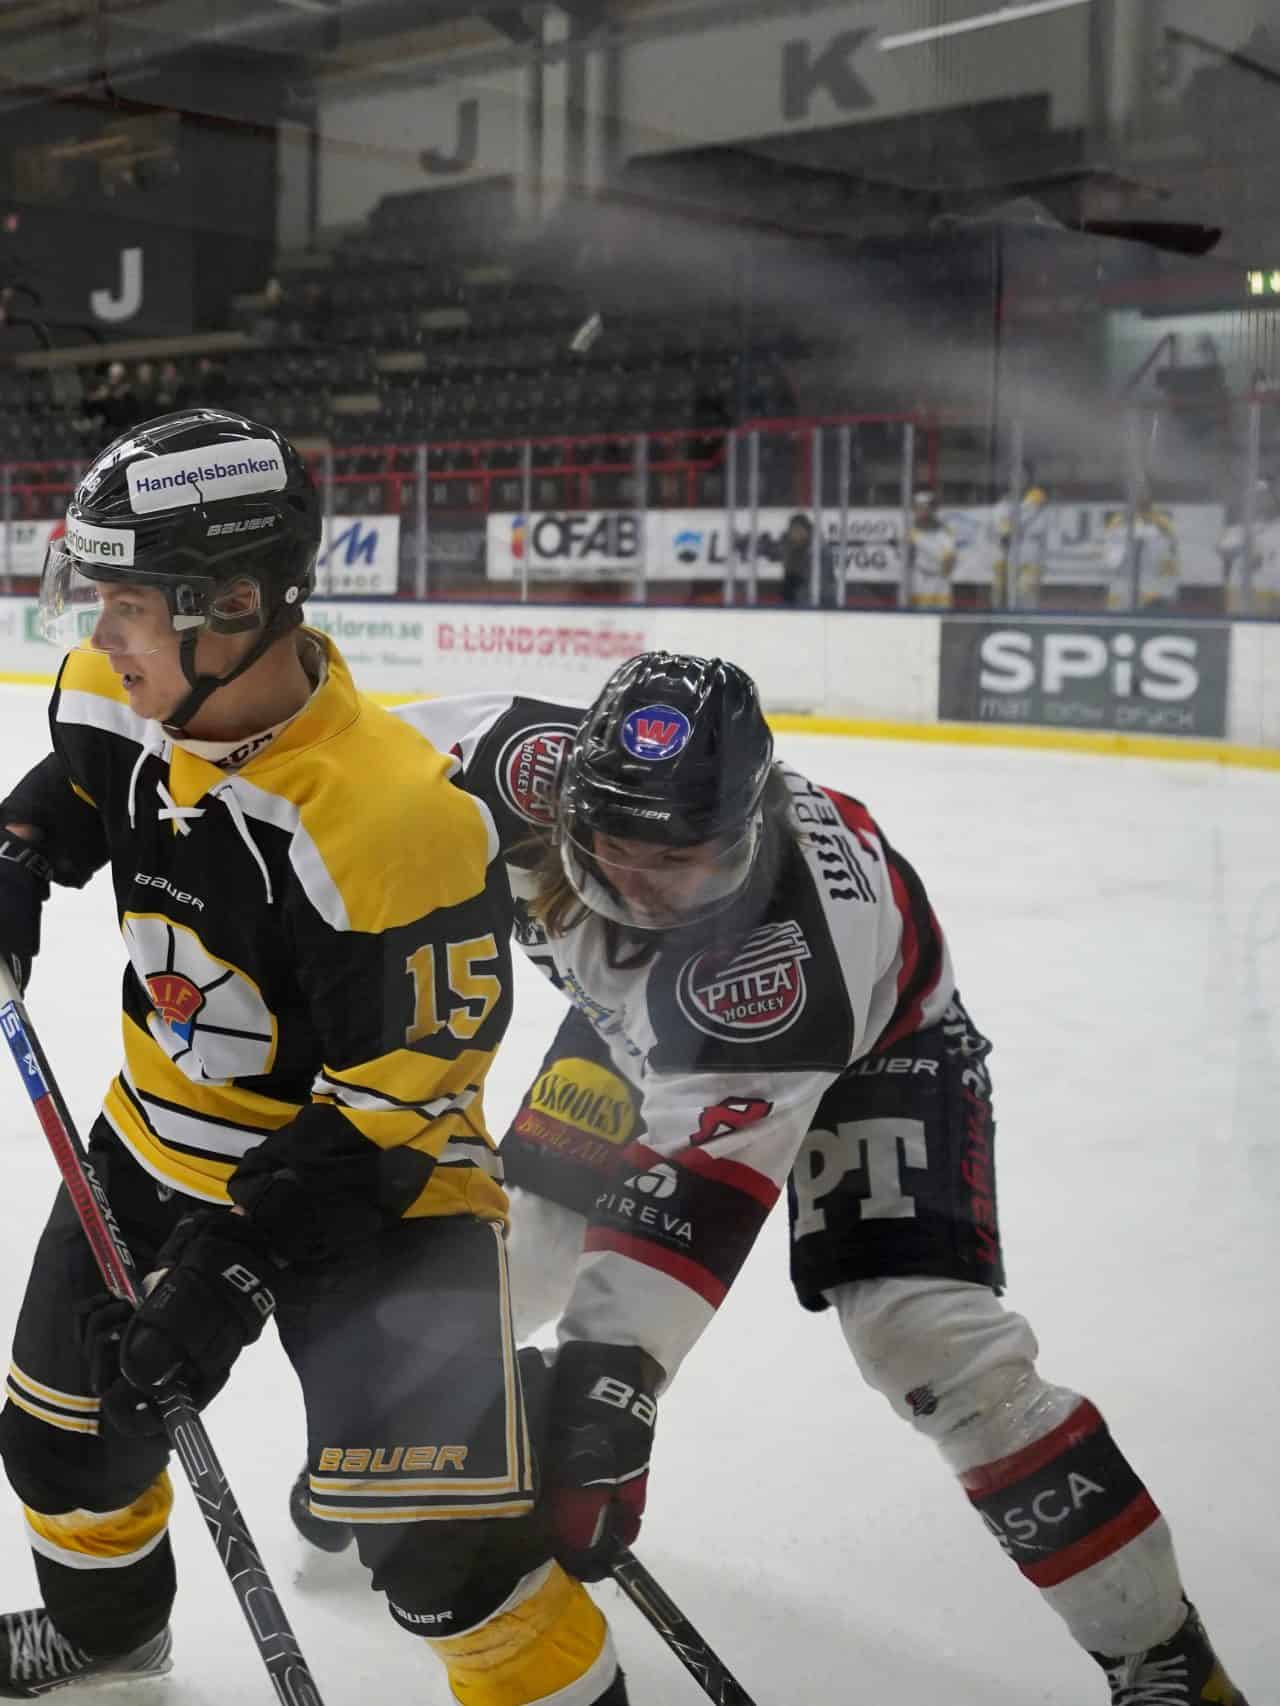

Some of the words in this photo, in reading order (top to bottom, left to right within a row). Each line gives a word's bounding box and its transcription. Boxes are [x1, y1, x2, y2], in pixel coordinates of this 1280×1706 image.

[782, 28, 878, 120] K
[423, 100, 478, 173] J
[92, 248, 142, 320] J
[136, 457, 280, 493] Handelsbanken
[133, 872, 206, 912] BAUER
[405, 932, 503, 1047] 15
[723, 995, 785, 1024] HOCKEY
[81, 1159, 138, 1269] NEXUS
[318, 1444, 469, 1473] BAUER
